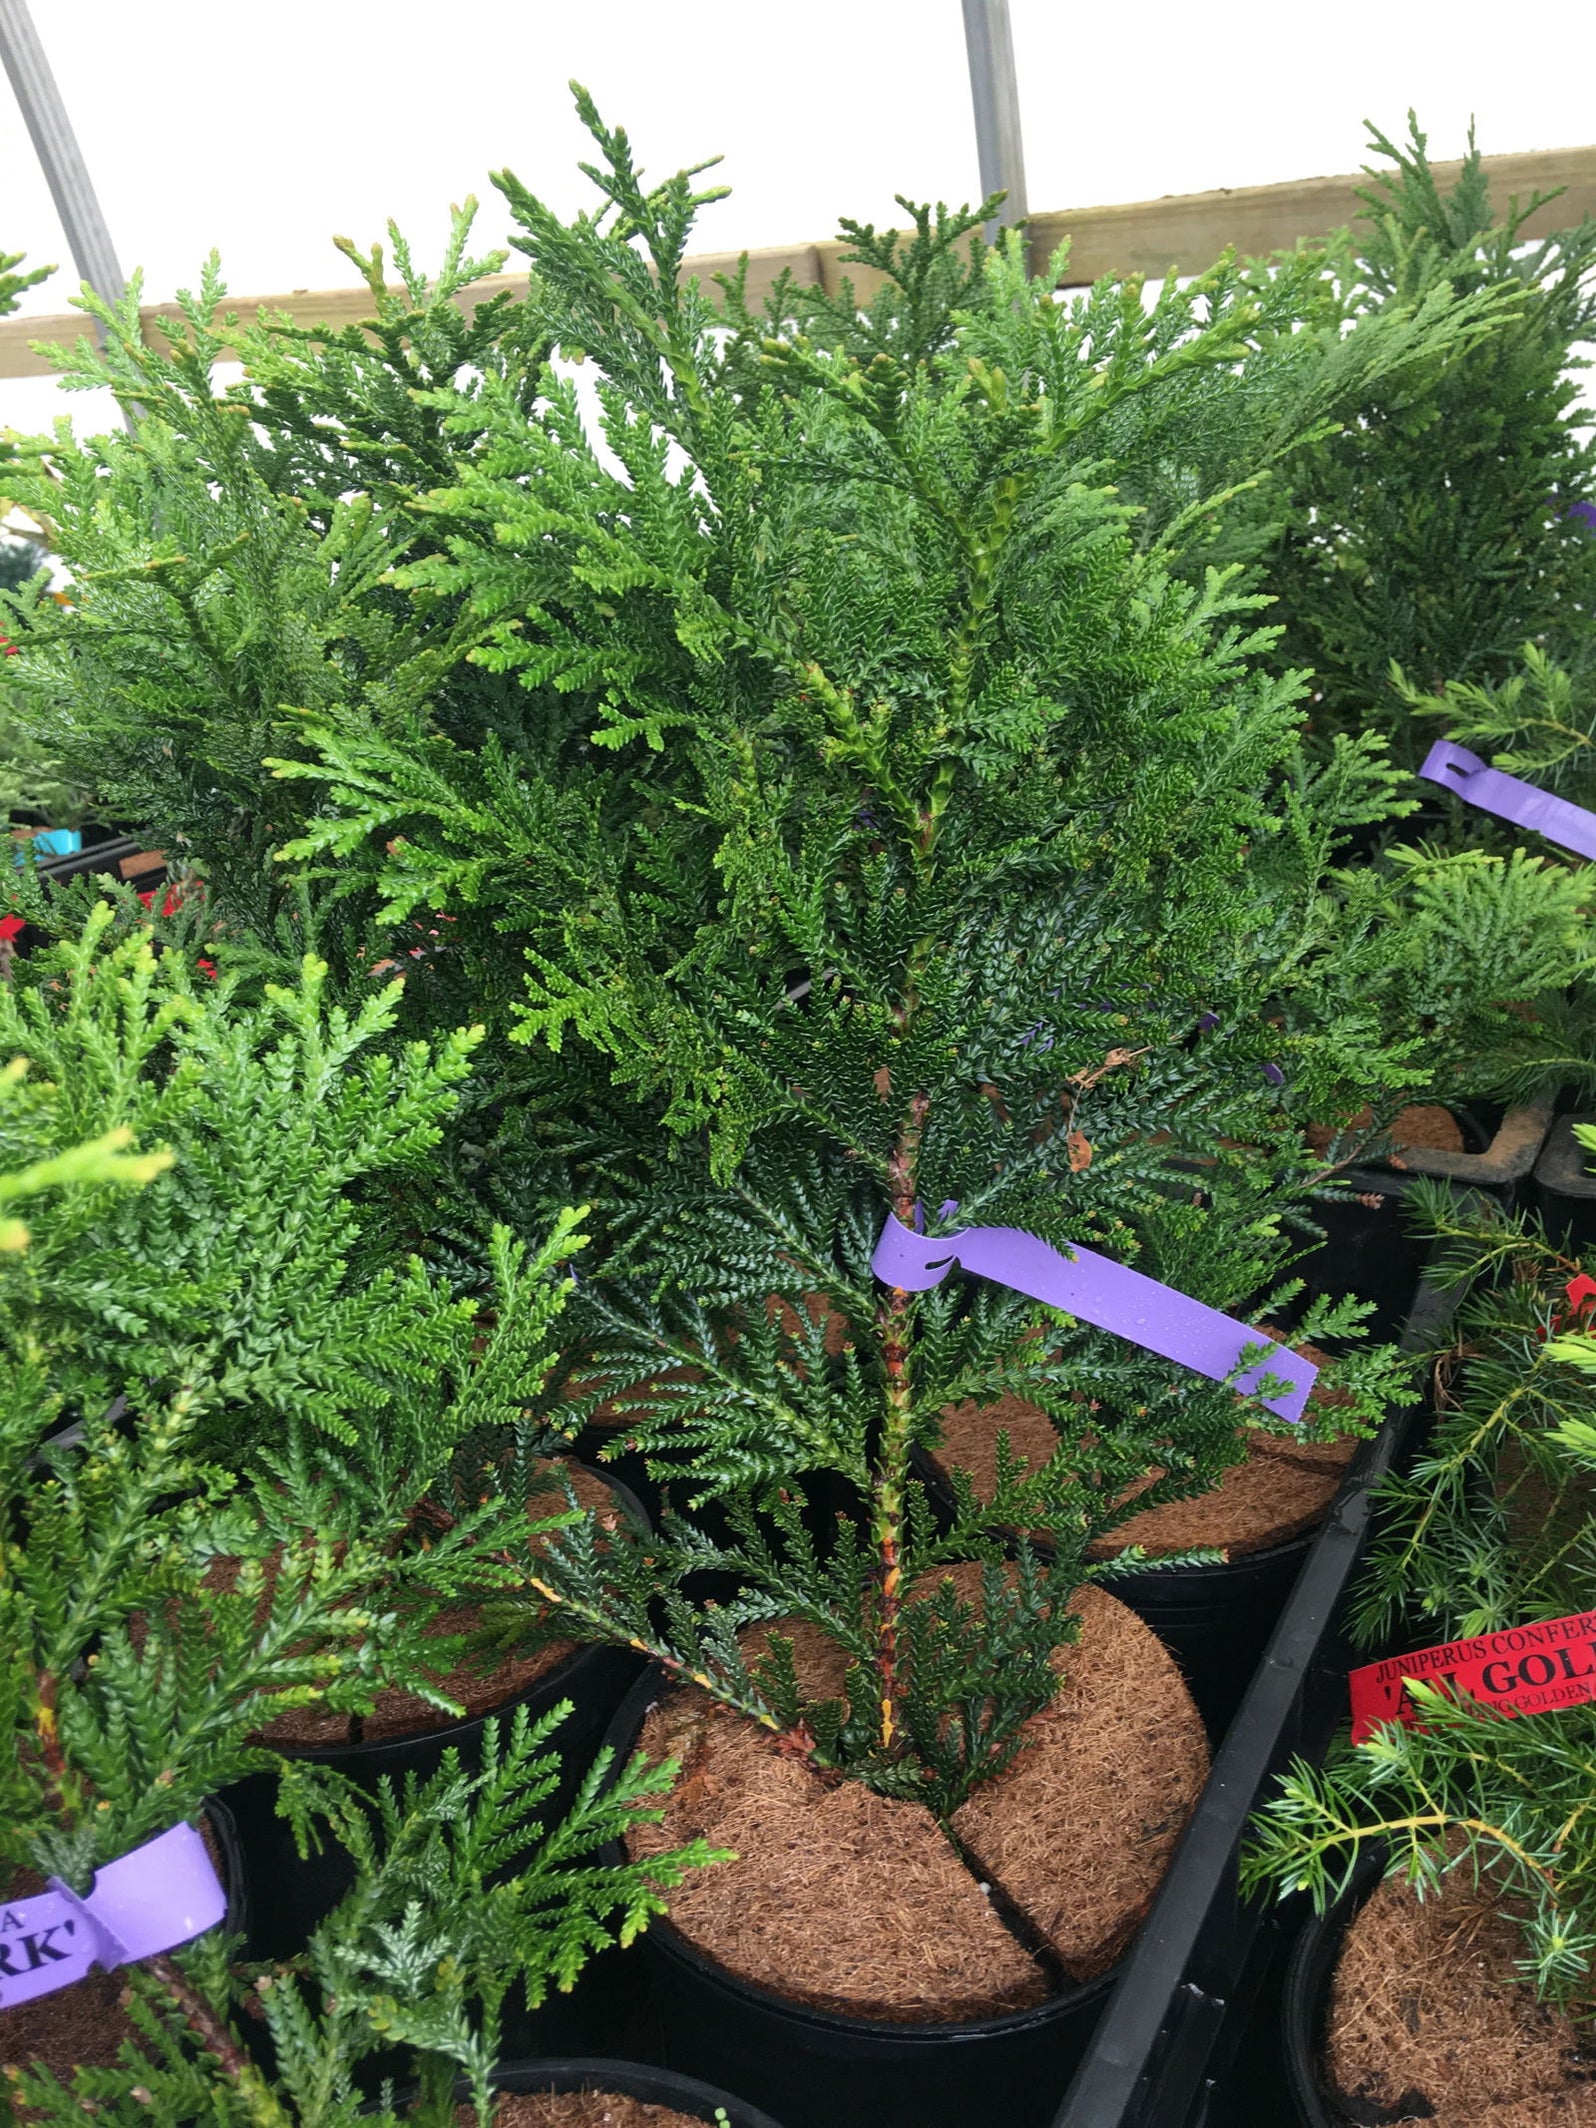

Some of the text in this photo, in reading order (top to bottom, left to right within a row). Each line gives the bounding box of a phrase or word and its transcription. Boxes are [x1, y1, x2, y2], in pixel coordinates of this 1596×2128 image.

[1376, 1613, 1596, 1683] JUNIPERUS CONFER
[1482, 1641, 1596, 1693] GOL
[1514, 1682, 1592, 1709] GOLDEN
